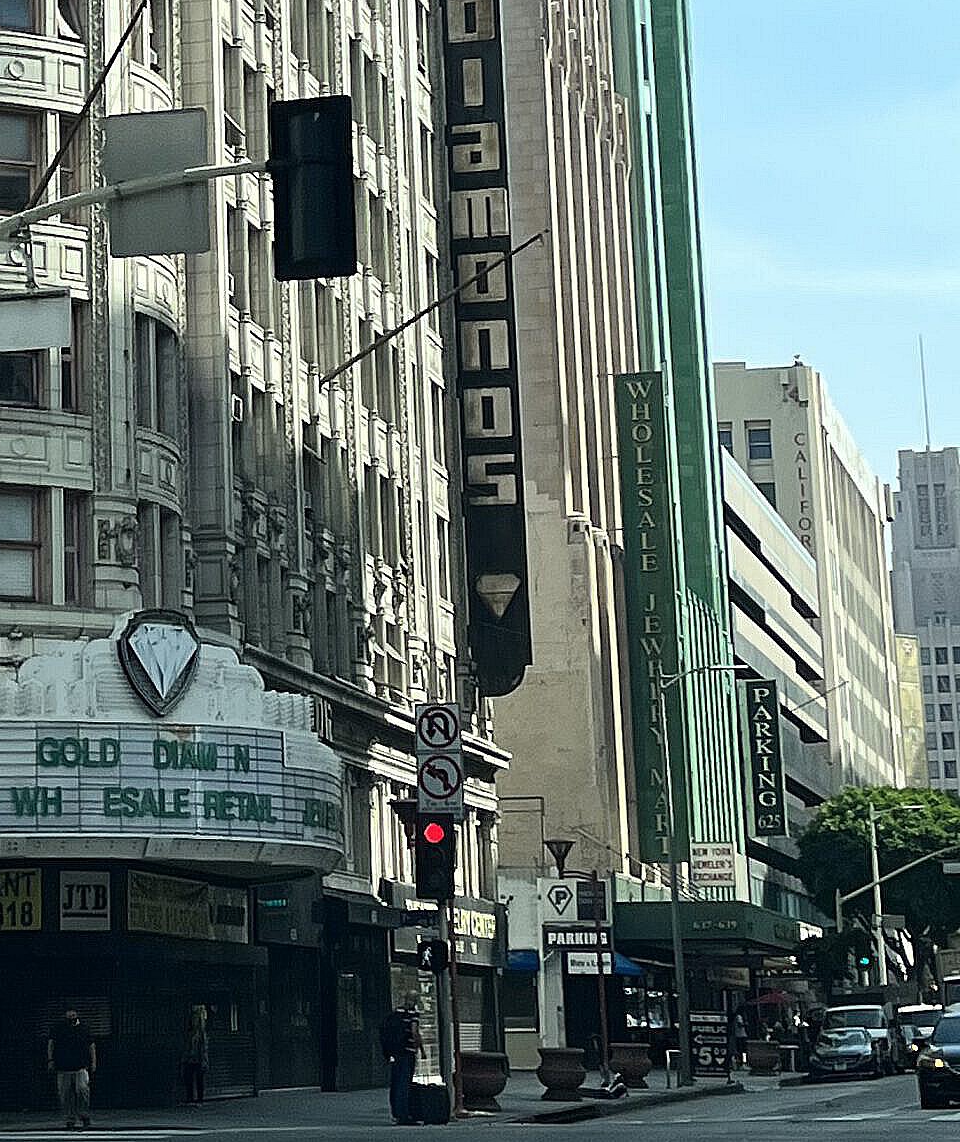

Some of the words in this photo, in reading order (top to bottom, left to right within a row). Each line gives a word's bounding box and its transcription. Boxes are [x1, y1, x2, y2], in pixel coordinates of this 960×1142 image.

[626, 380, 660, 573] WHOLESALE
[40, 737, 120, 768] GOLD
[752, 687, 778, 807] PARKING
[203, 790, 277, 824] RETAIL
[758, 814, 782, 829] 625
[548, 932, 608, 945] PARKING
